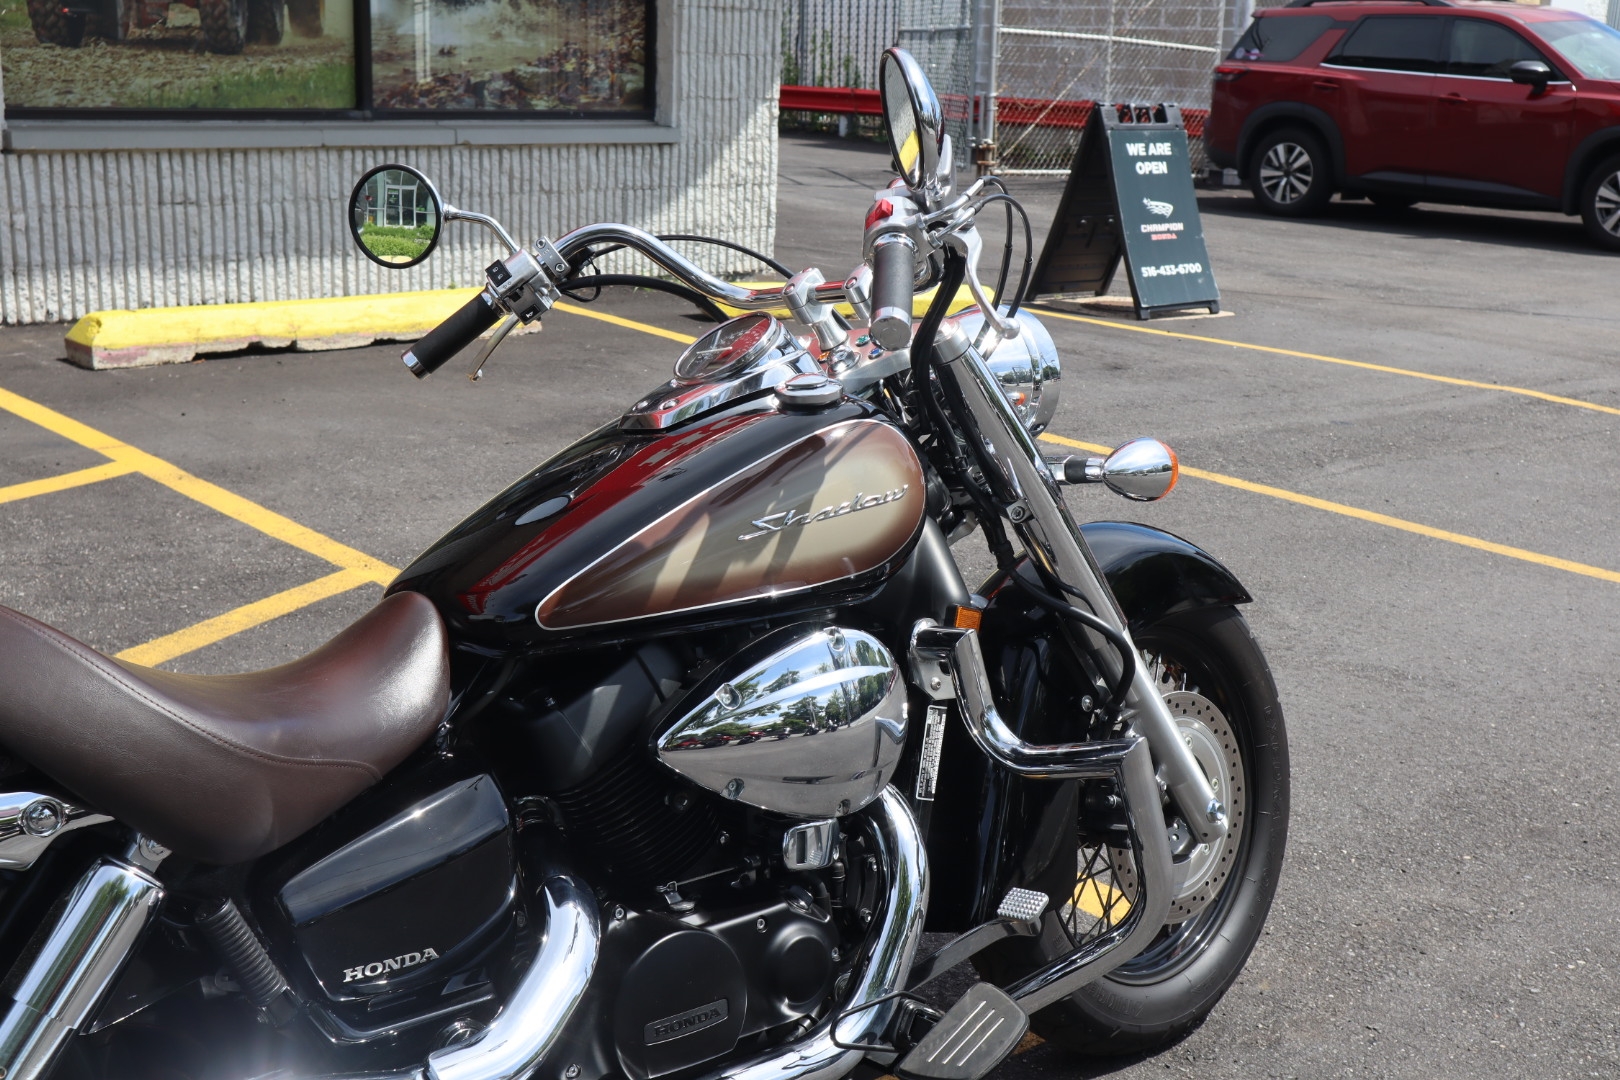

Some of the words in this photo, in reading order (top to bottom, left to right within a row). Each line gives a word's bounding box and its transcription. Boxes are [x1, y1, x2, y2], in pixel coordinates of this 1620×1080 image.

[1126, 143, 1146, 156] WE
[1150, 143, 1172, 156] ARE
[1135, 161, 1168, 175] OPEN
[1141, 222, 1184, 233] CHAMPION
[1141, 262, 1202, 278] 516-433-6700
[737, 484, 909, 541] Shadow
[343, 947, 439, 982] HONDA
[654, 1007, 721, 1037] HONDA
